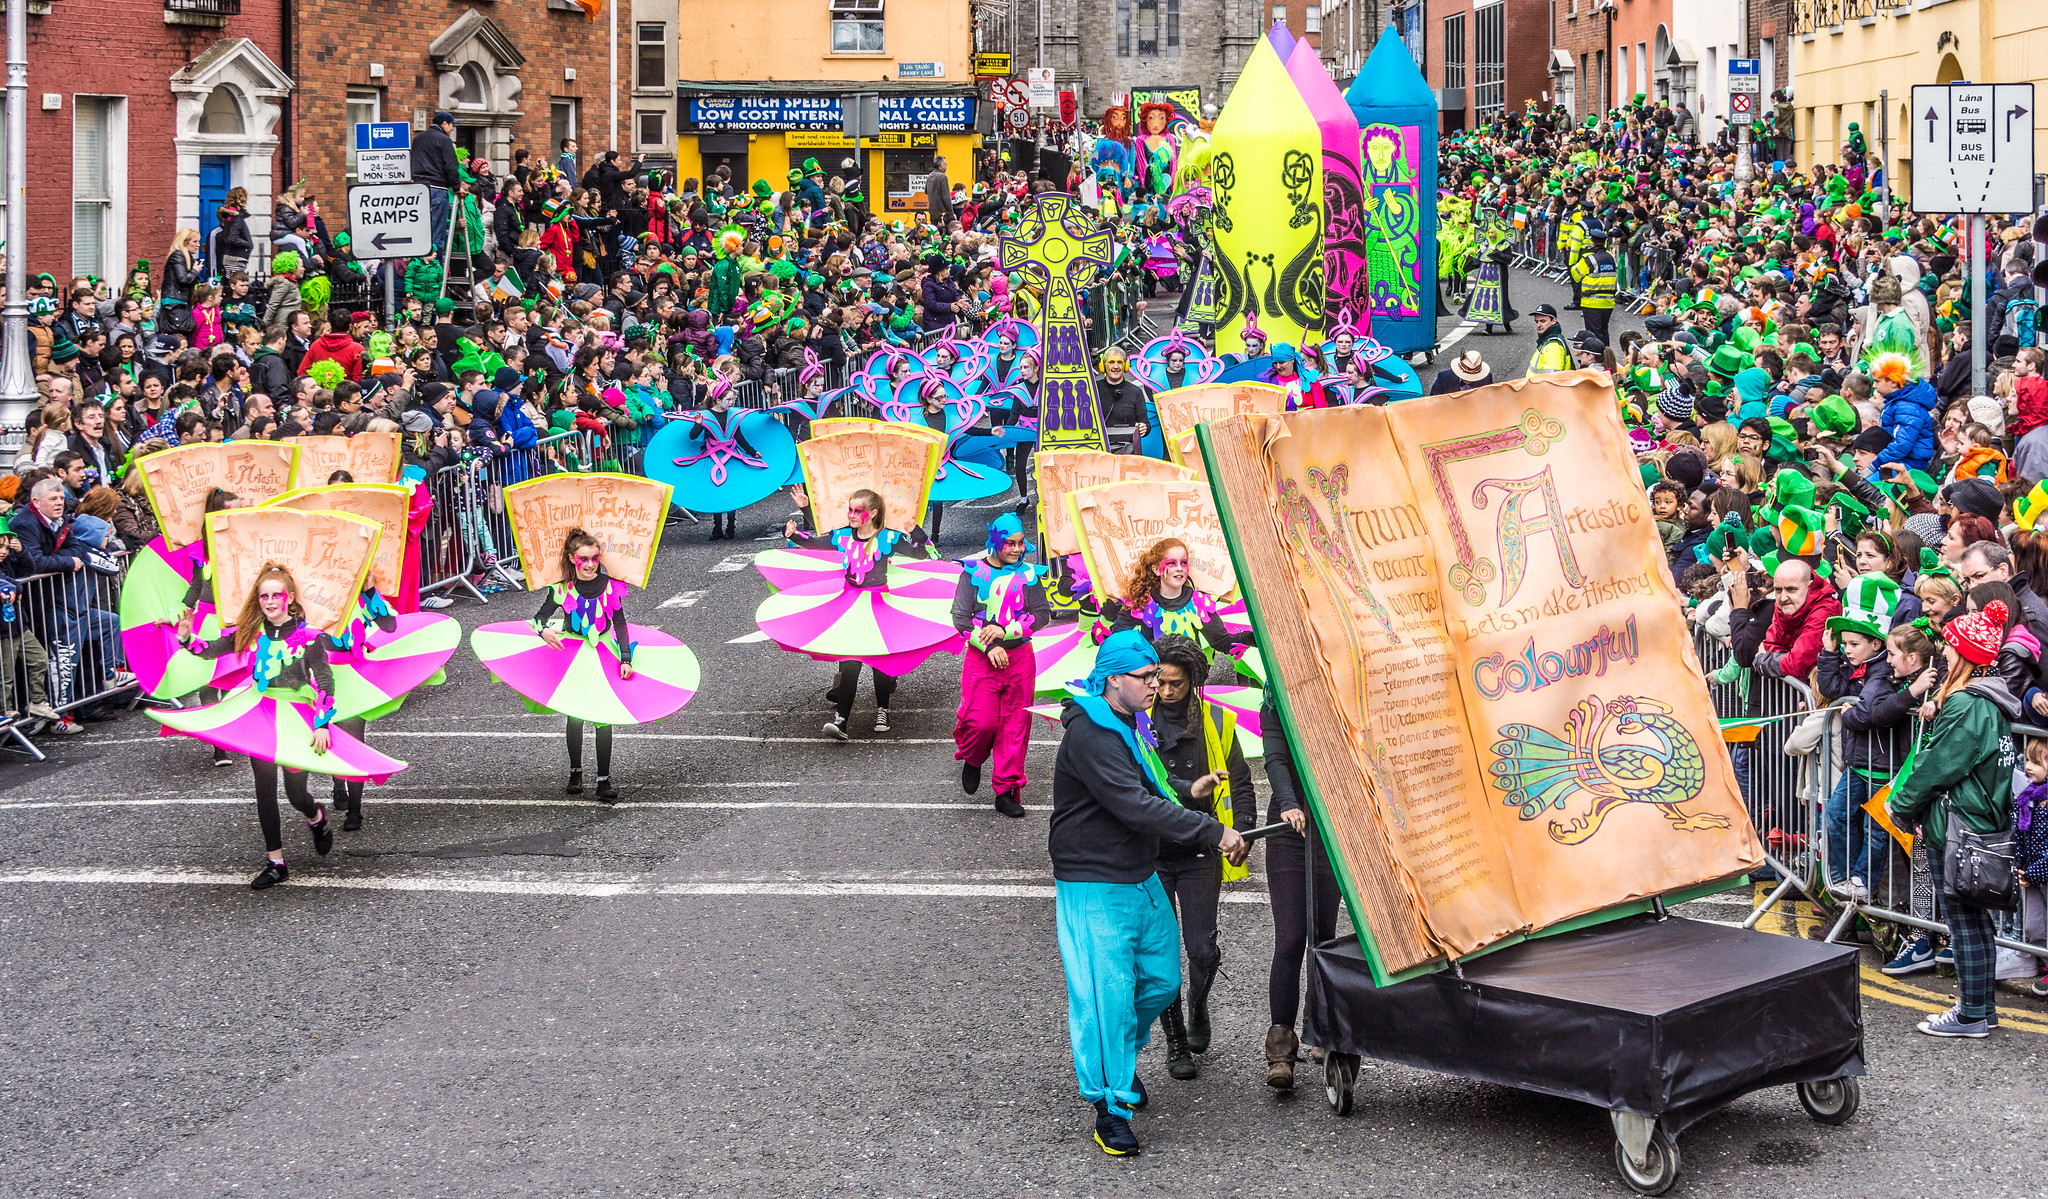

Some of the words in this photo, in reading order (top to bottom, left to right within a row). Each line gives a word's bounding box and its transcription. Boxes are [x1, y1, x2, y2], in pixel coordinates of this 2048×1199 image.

[741, 97, 779, 108] HIGH
[785, 97, 830, 108] SPEED
[911, 97, 965, 109] ACCESS
[1959, 94, 1983, 102] Lána
[697, 110, 733, 121] LOW
[738, 110, 778, 121] COST
[917, 110, 966, 121] CALLS
[1013, 112, 1025, 122] 50
[727, 122, 797, 130] PHOTOCOPYING
[810, 122, 828, 130] CV's
[912, 133, 935, 148] yes!
[1961, 143, 1982, 151] BUS
[384, 153, 406, 161] Domh
[370, 163, 381, 171] 24
[364, 172, 383, 180] MON
[388, 171, 405, 179] SUN
[360, 192, 423, 208] Rampaí
[891, 198, 906, 207] Ria
[362, 210, 419, 225] RAMPS
[596, 496, 652, 522] Artastic
[1459, 611, 1519, 642] Let's
[1522, 584, 1582, 625] make
[1581, 570, 1657, 610] History
[1471, 613, 1639, 701] Colourful
